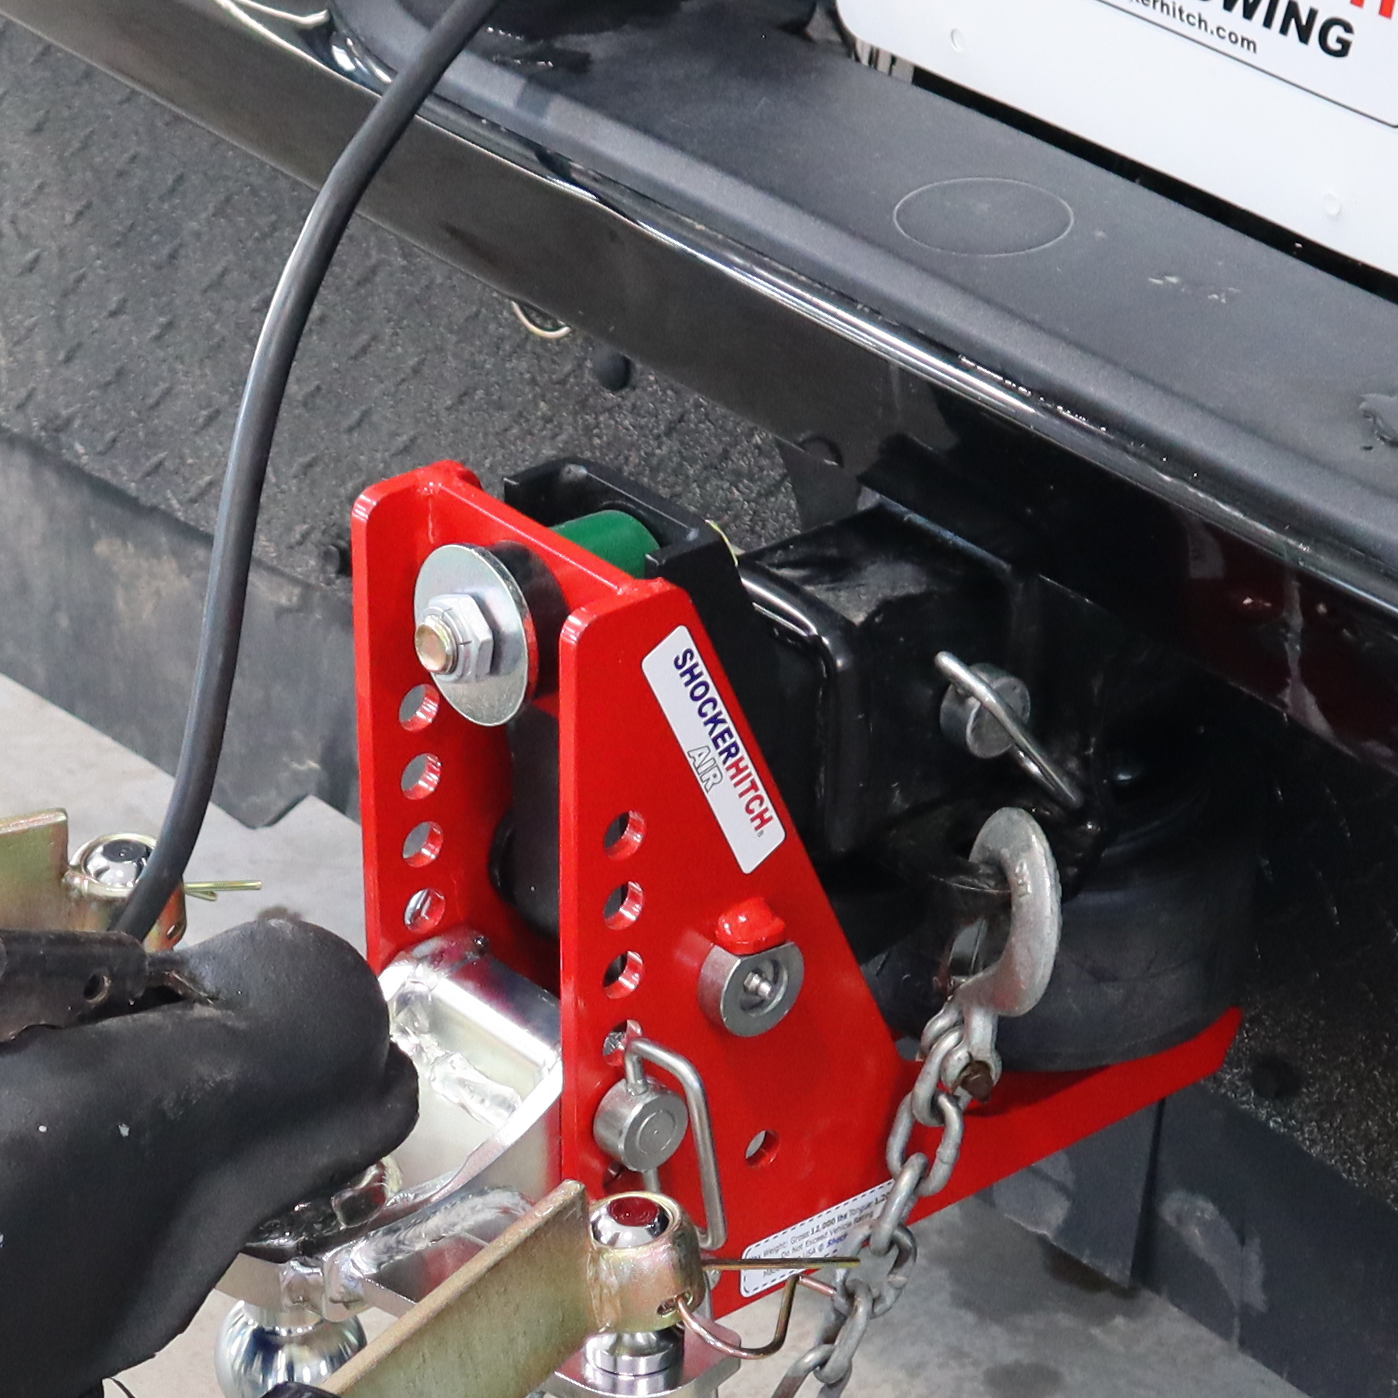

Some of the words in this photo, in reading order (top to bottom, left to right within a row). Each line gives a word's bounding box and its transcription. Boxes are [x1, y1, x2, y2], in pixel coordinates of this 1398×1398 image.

[1130, 0, 1258, 54] erhitch.com
[1200, 0, 1355, 58] WING
[673, 648, 773, 832] SHOCKERHITCH
[687, 745, 723, 793] AIR
